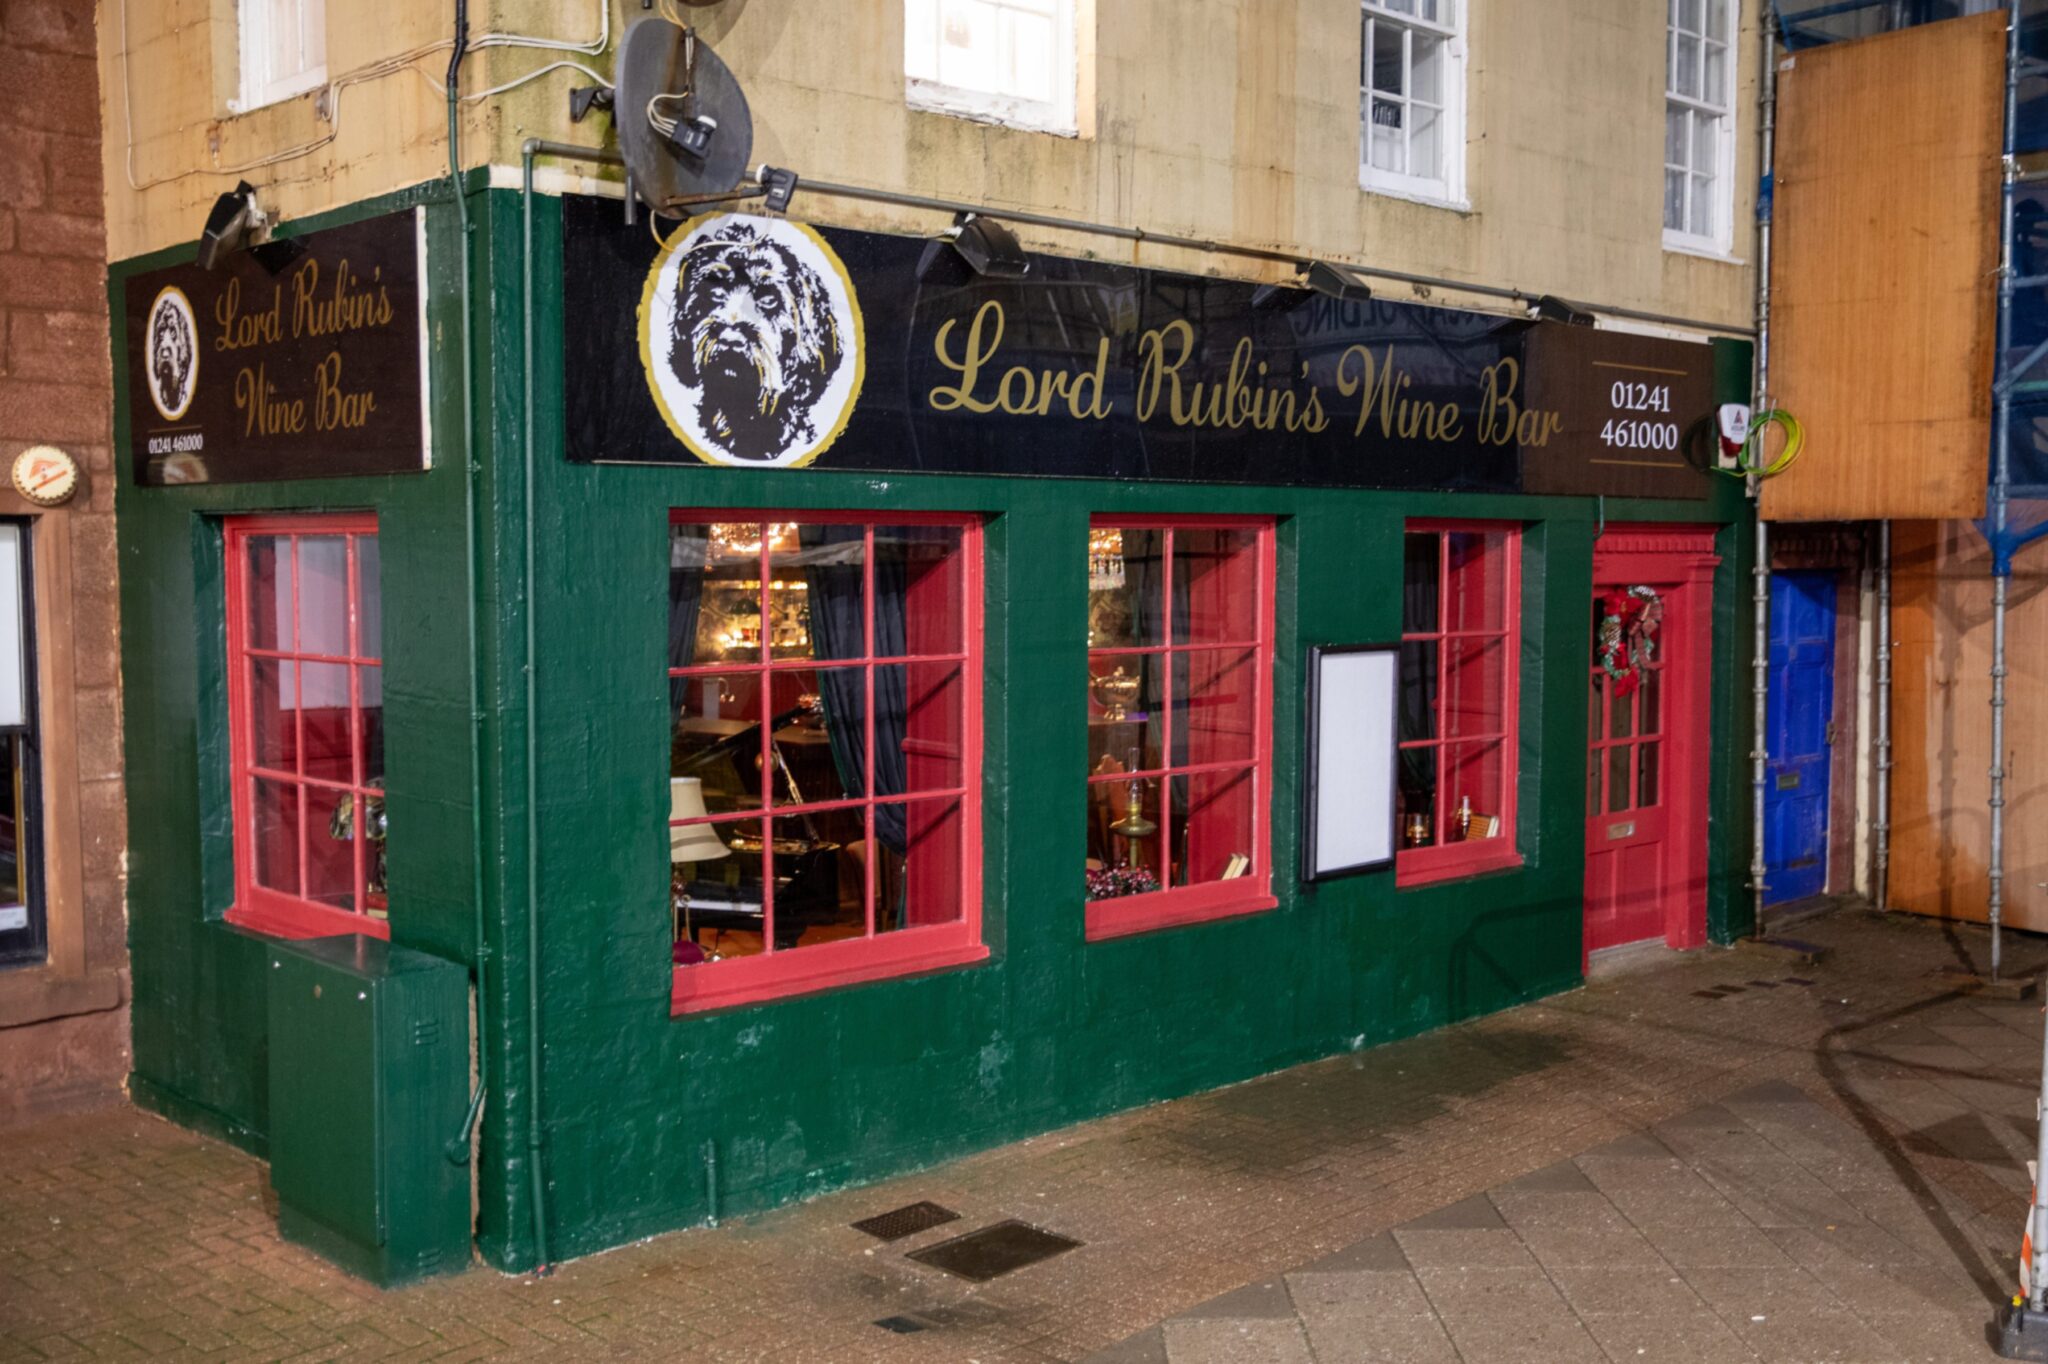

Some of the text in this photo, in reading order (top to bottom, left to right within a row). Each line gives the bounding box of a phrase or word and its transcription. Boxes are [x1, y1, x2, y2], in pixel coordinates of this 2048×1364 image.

[215, 258, 394, 351] Lord Rubin's
[235, 351, 377, 437] Wine Bar
[929, 299, 1564, 448] Lord Rubin's Wine Bar
[1610, 380, 1671, 413] 01241
[148, 432, 204, 454] 01241 461000
[1600, 419, 1679, 451] 461000
